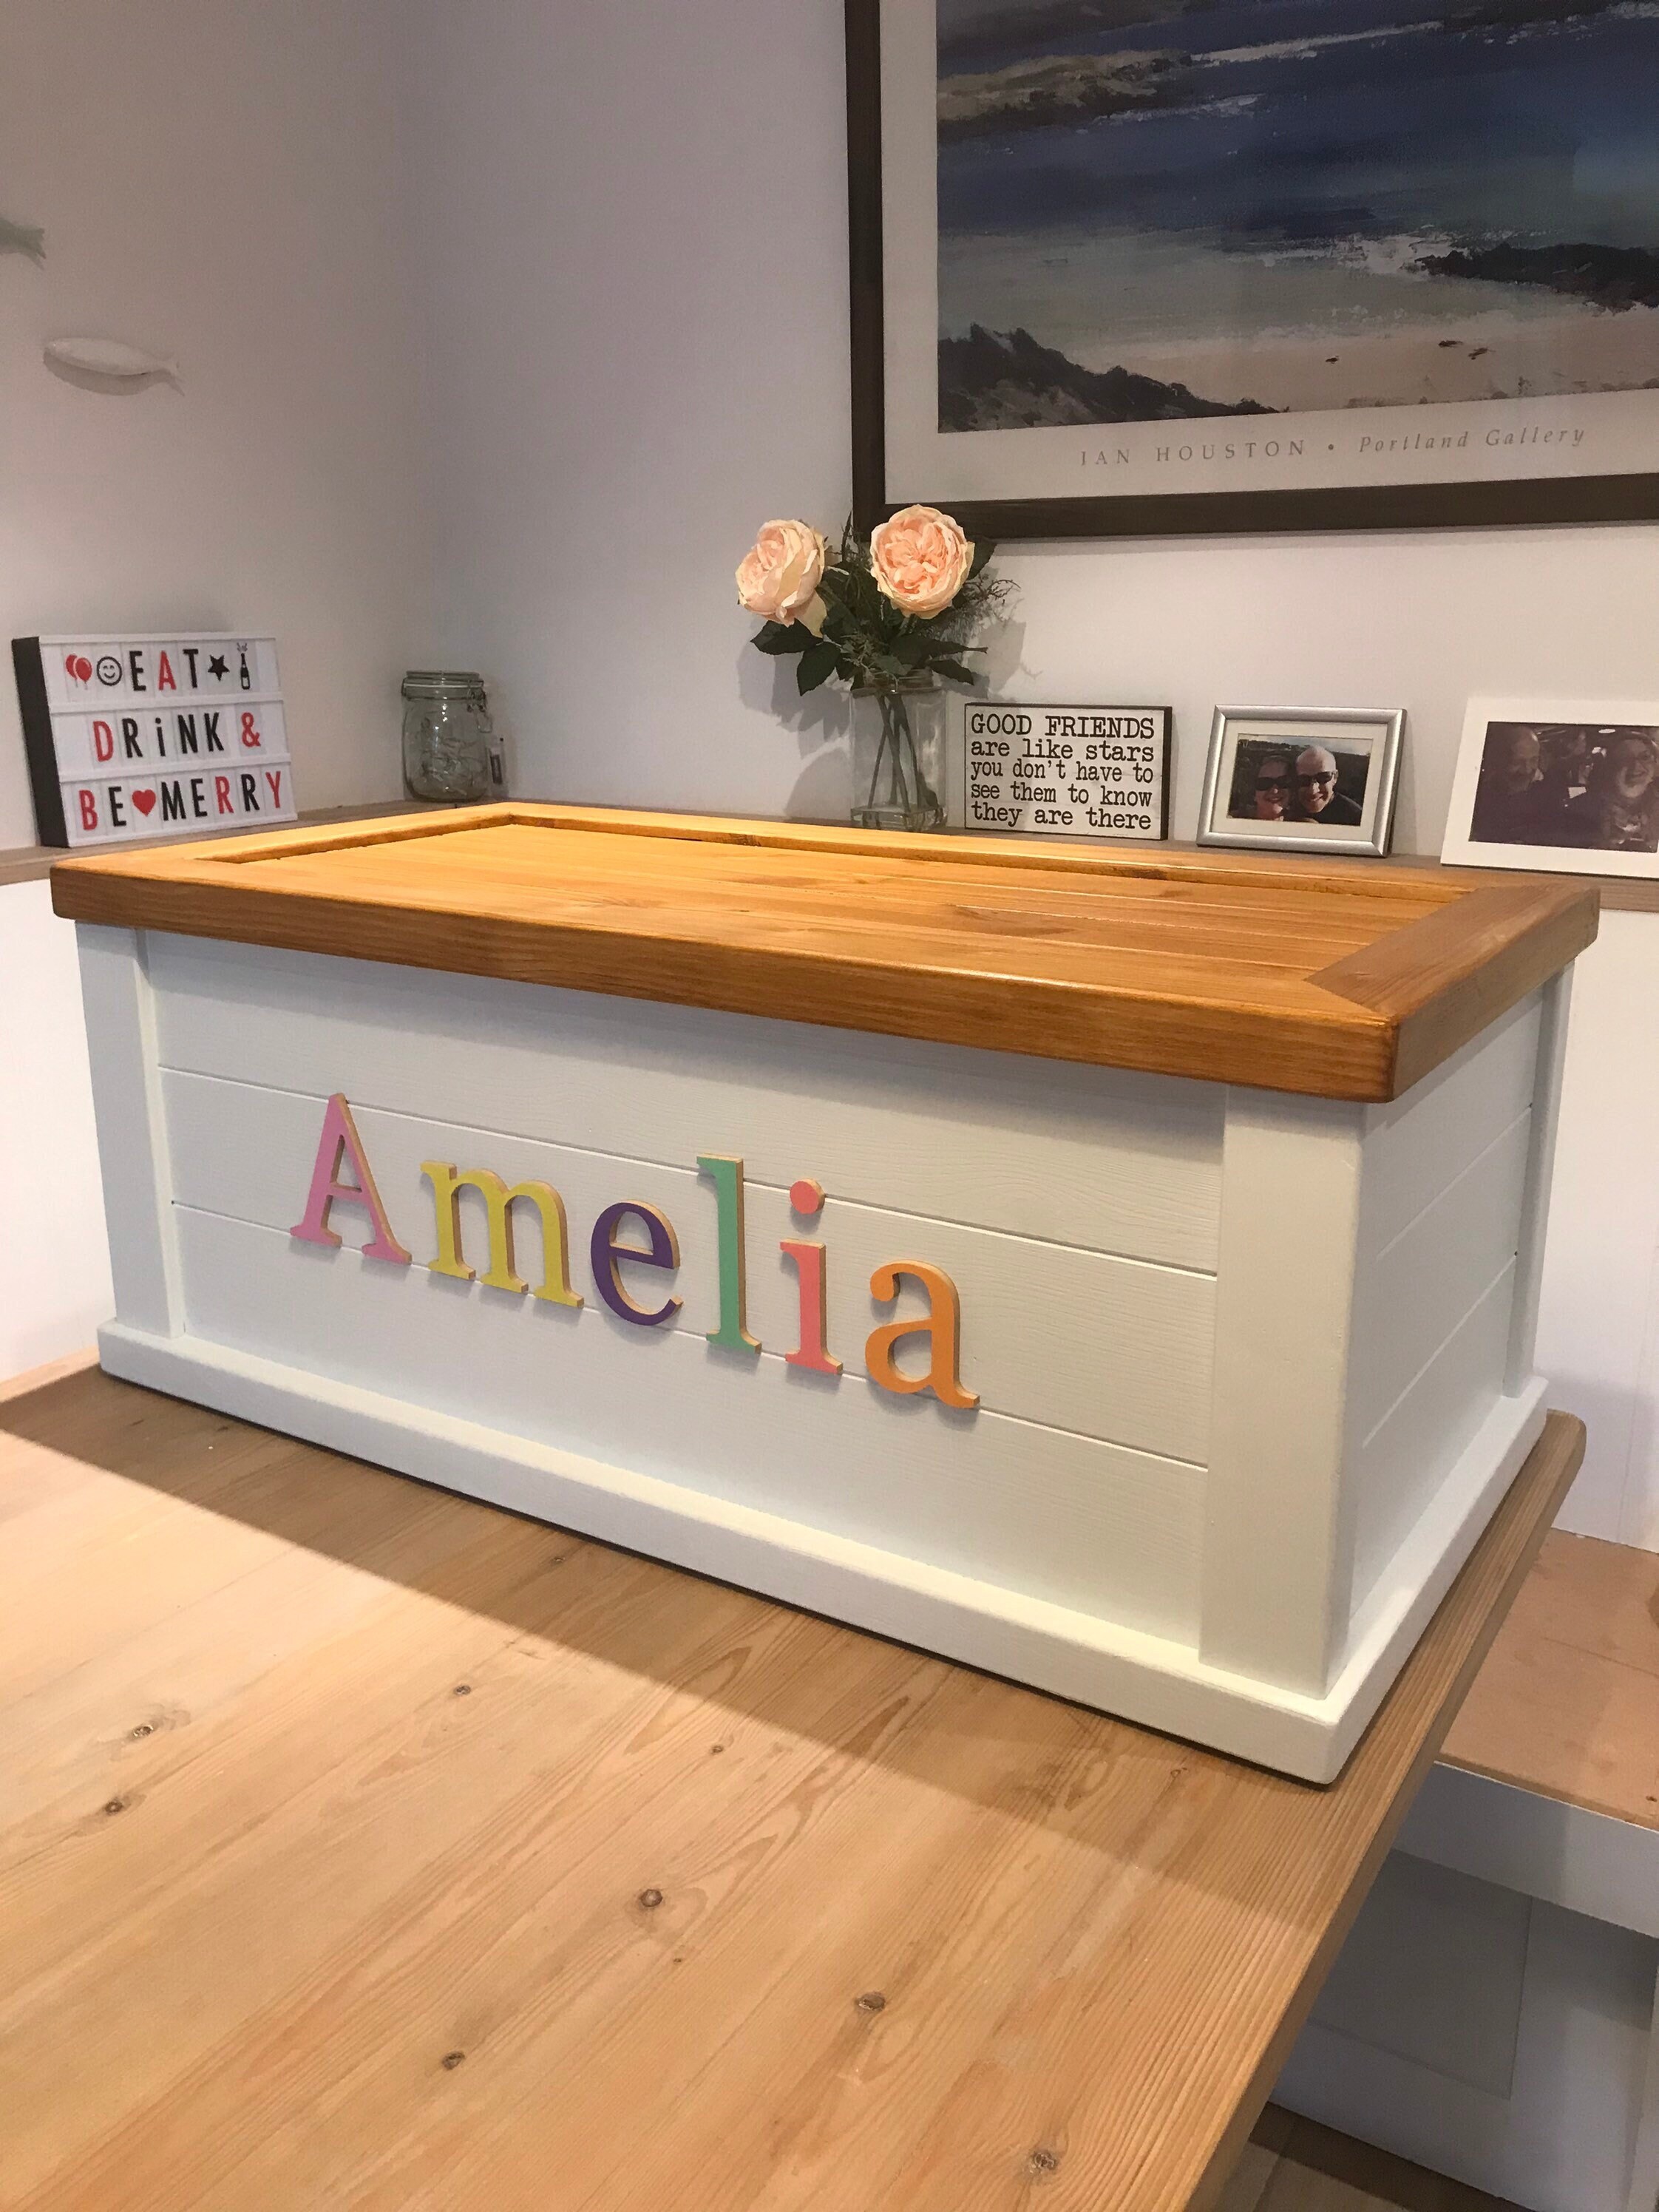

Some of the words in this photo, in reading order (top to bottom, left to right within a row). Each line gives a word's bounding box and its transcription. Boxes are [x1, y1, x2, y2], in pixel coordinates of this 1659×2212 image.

[1081, 448, 1130, 466] IAN
[1156, 439, 1304, 462] HOUSTON
[1359, 431, 1469, 452] Portland
[1485, 426, 1585, 447] Gallery
[129, 648, 199, 691] EAT
[240, 711, 261, 747] &
[971, 713, 1032, 736] GOOD
[1045, 715, 1155, 739] FRIENDS
[971, 740, 1011, 757] are
[1022, 738, 1073, 759] like
[1085, 740, 1154, 762] stars
[970, 760, 1003, 781] you
[1012, 758, 1066, 779] don't
[1075, 761, 1123, 782] have
[1133, 762, 1153, 784] to
[78, 786, 127, 831] BE
[160, 770, 282, 822] MERRY
[971, 783, 1000, 799] see
[1010, 781, 1056, 804] them
[1068, 784, 1089, 804] to
[1100, 785, 1153, 807] know
[971, 802, 1023, 828] they
[1034, 808, 1073, 826] are
[1085, 806, 1152, 830] there
[290, 1092, 980, 1409] Amelia
